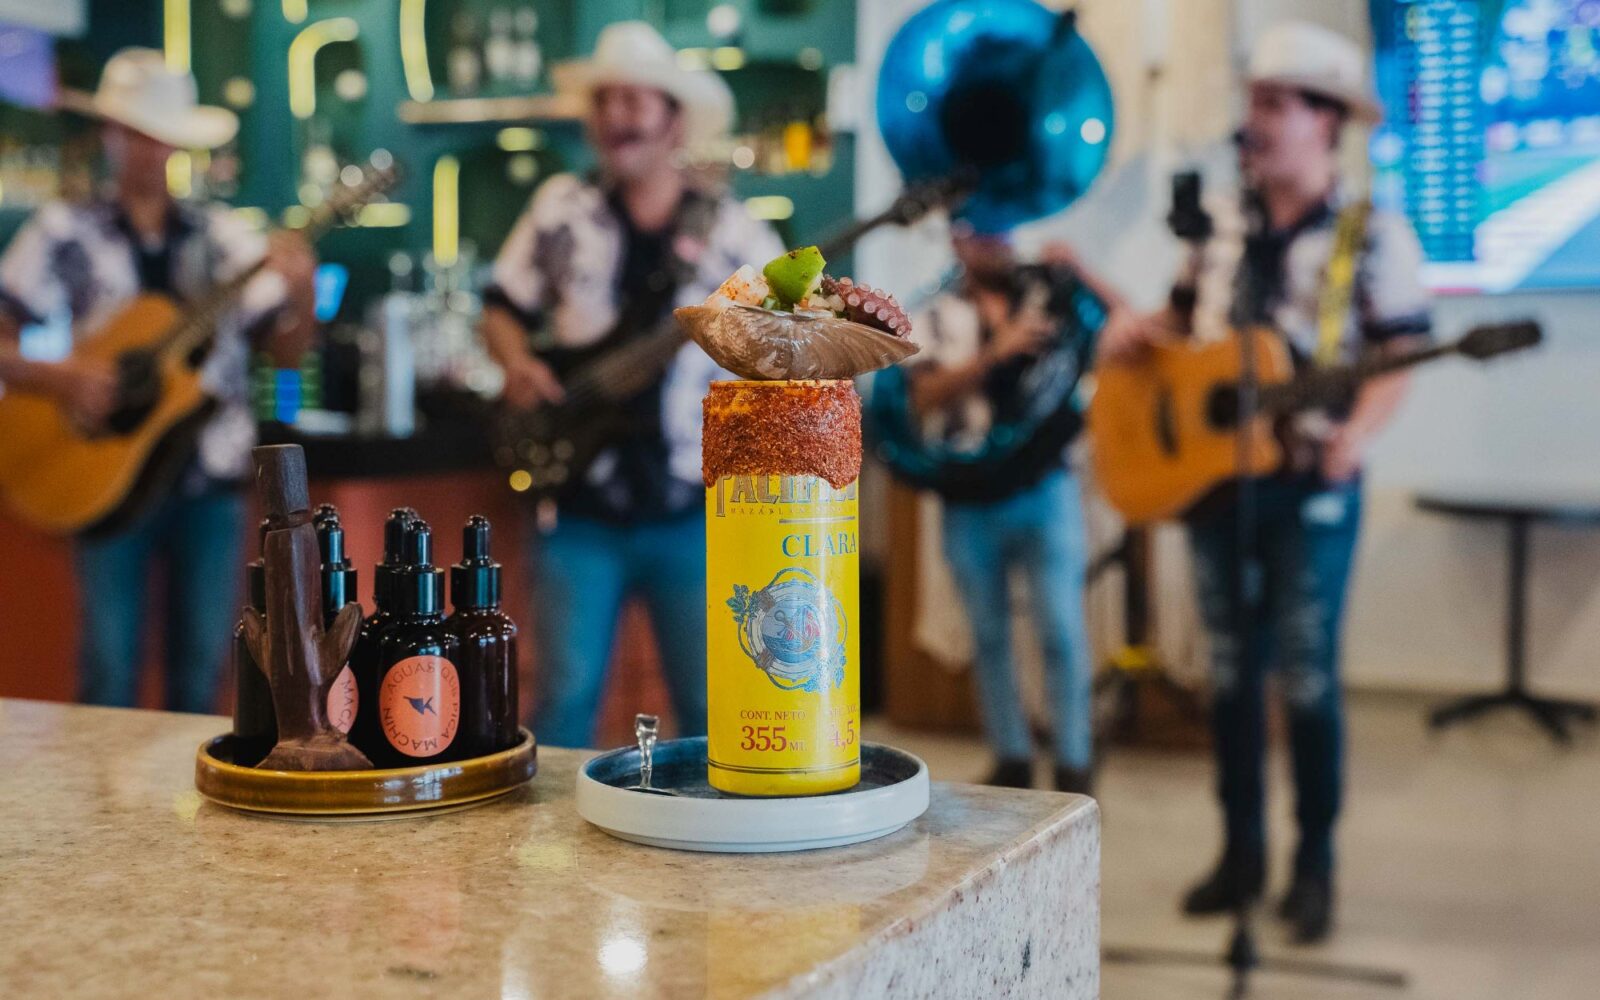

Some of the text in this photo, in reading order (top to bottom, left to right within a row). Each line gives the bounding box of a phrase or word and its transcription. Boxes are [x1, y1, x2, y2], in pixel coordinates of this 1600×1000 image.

[781, 532, 857, 558] CLARA
[387, 662, 436, 696] AGUAS
[383, 707, 438, 751] MACHIN
[440, 702, 458, 740] PICA
[740, 709, 806, 721] CONT. NETO
[740, 725, 787, 752] 355
